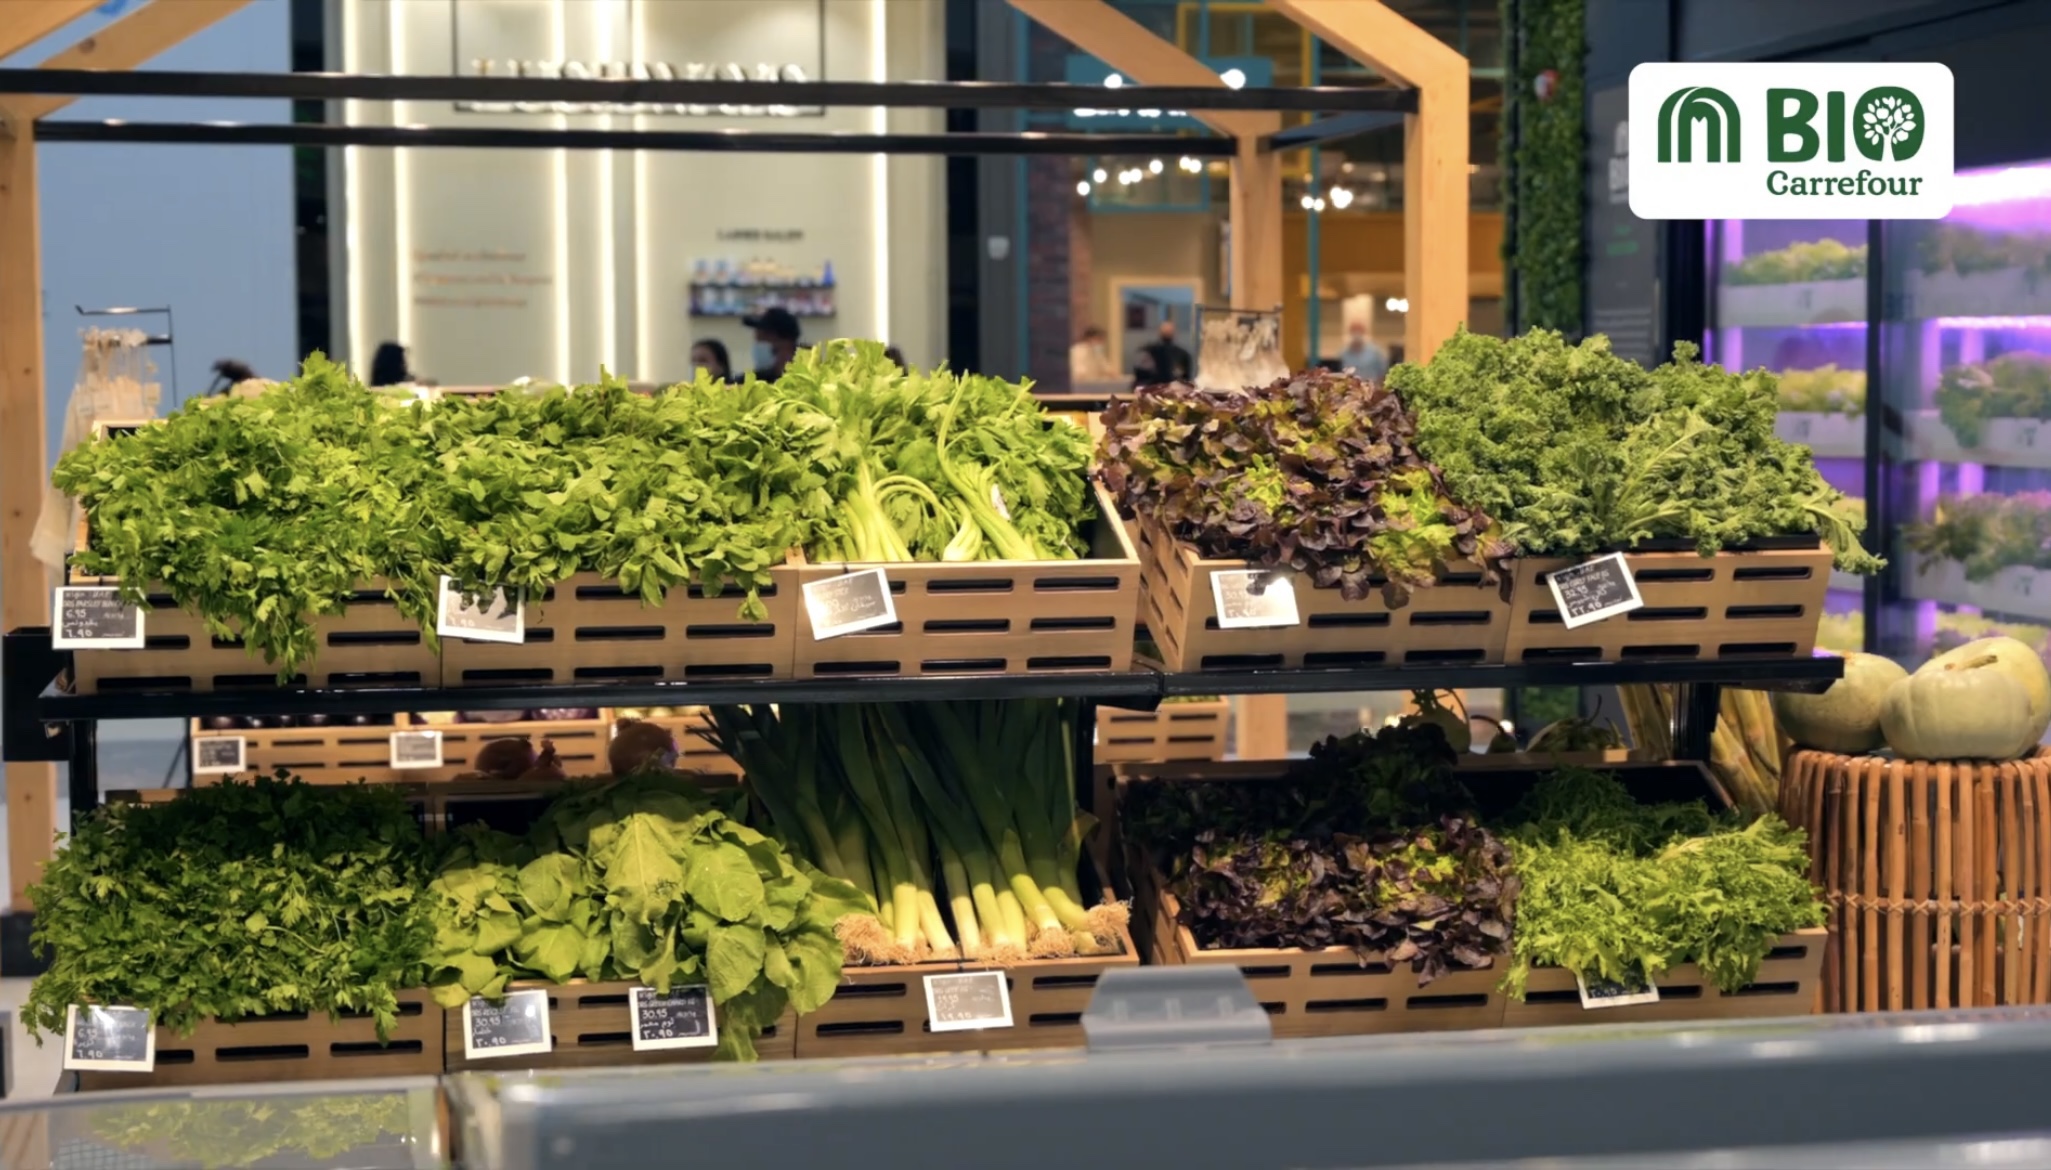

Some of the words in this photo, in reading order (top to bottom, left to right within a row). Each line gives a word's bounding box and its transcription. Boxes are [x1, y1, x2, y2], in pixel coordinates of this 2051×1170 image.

[65, 609, 87, 619] 6.95
[642, 1008, 668, 1019] 30.95
[475, 1016, 501, 1028] 30.95
